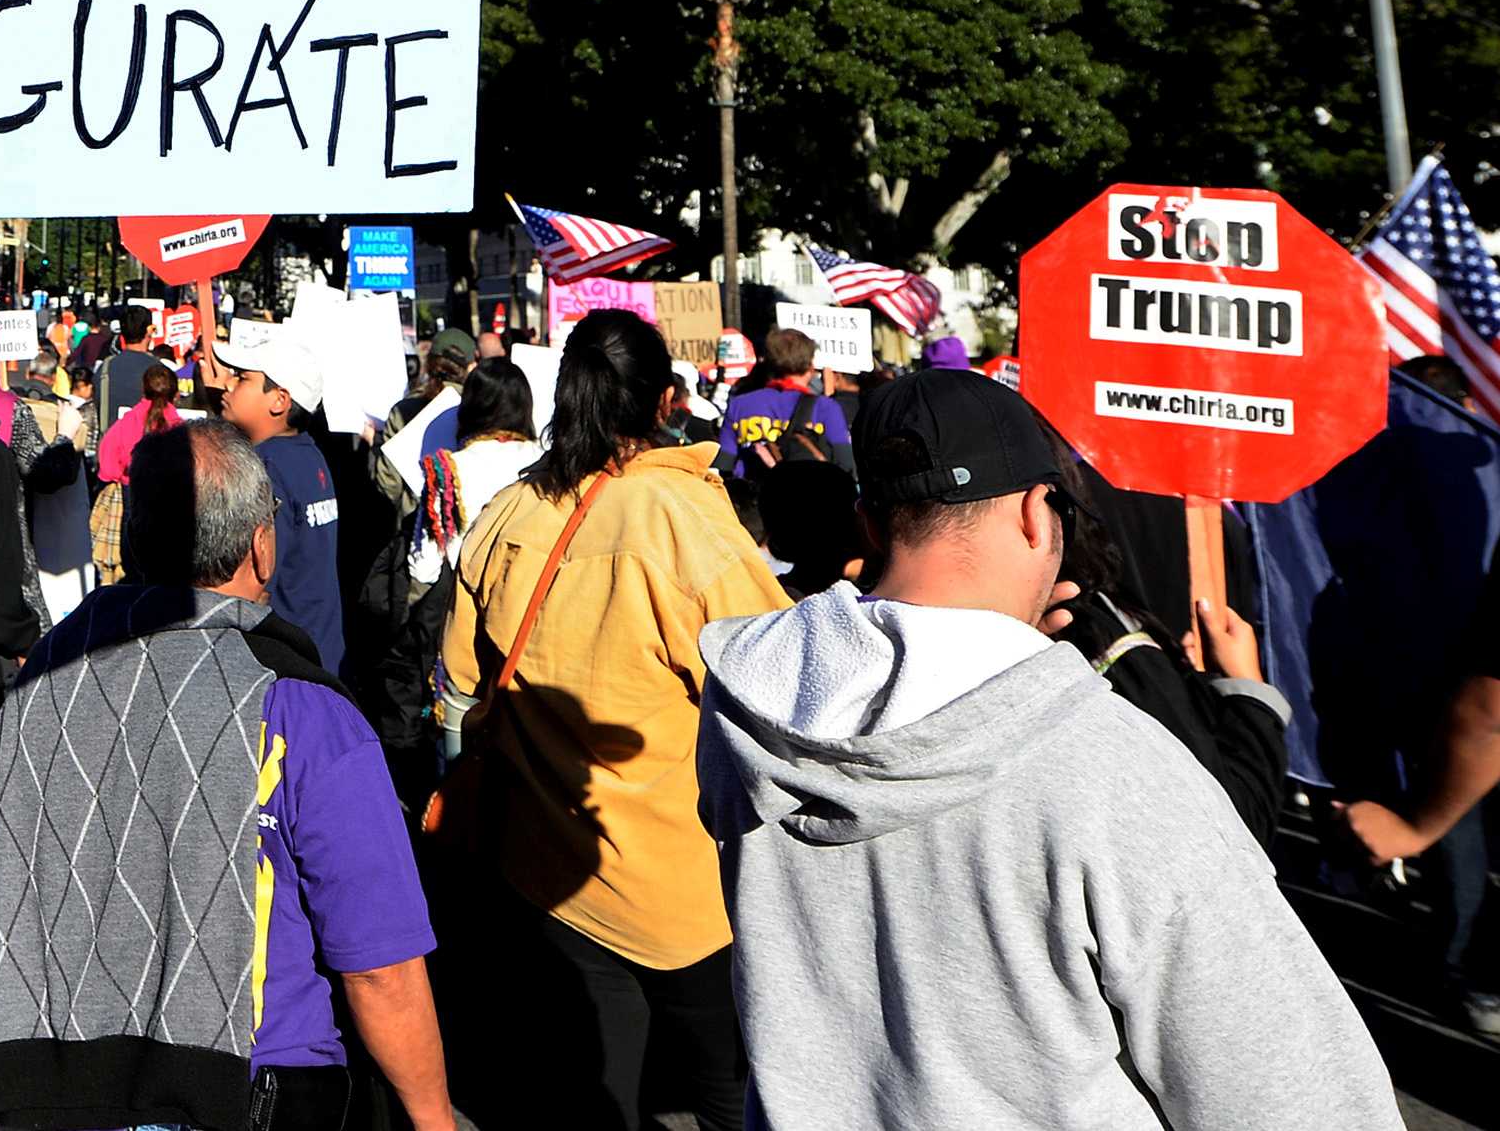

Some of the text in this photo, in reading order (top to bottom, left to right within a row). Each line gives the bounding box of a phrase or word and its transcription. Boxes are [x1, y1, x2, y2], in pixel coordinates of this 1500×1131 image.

[163, 226, 237, 252] www.chirla.org
[362, 231, 397, 242] MAKE
[1120, 205, 1263, 267] Stop
[354, 243, 409, 254] AMERICA
[354, 256, 409, 275] THINK
[363, 275, 402, 287] AGAIN
[793, 312, 858, 330] FEARLESS
[1098, 277, 1292, 349] Trump
